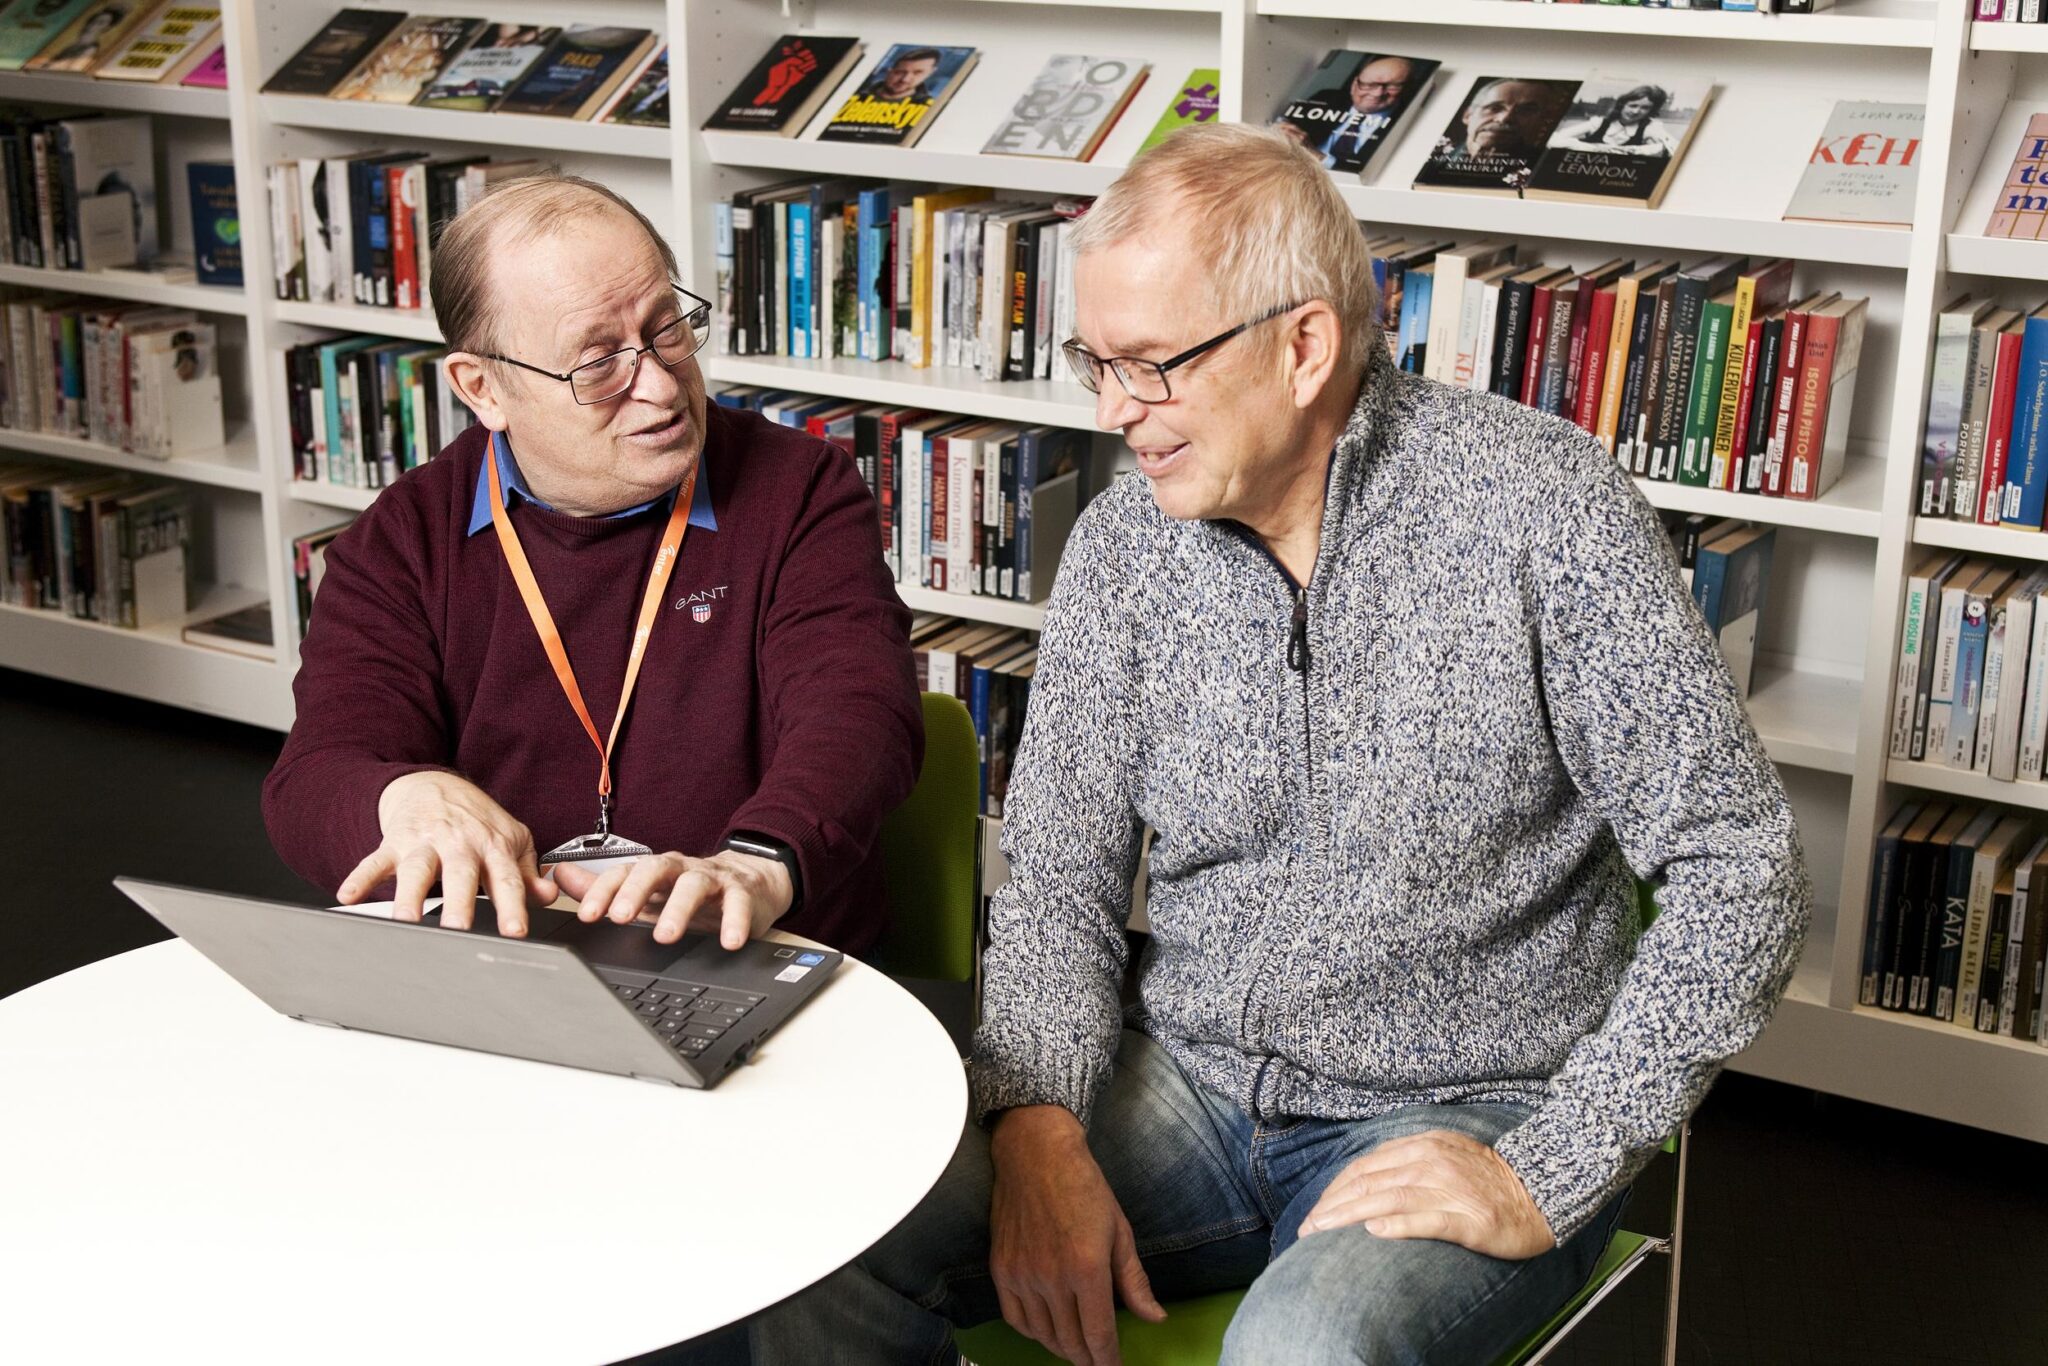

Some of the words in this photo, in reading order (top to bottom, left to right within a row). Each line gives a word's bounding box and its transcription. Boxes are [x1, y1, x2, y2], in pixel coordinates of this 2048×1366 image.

[1284, 104, 1391, 129] ILONIEMI
[1557, 161, 1638, 181] LENNON,
[1563, 151, 1609, 166] EEVA
[1014, 271, 1026, 297] GAME
[1013, 299, 1025, 325] PLAN
[1507, 290, 1521, 336] EIJA-RIITTA
[1560, 301, 1572, 338] PIRKKO
[1657, 300, 1670, 331] MARSKI
[1501, 337, 1515, 376] KORHOLA
[1667, 331, 1685, 380] ANTERO
[1722, 344, 1744, 402] KULLERVO
[1585, 351, 1600, 402] KOULUMIES
[1647, 359, 1661, 401] VARJONSA
[1978, 363, 1989, 388] JAN
[1658, 382, 1676, 442] SVENSSON
[1716, 404, 1735, 452] MANNER
[1967, 420, 1982, 484] ENSIMMÄI
[910, 450, 918, 506] KAMALA
[933, 475, 946, 512] HANNA
[952, 456, 968, 517] Kunnon
[910, 510, 918, 558] HARRIS
[953, 520, 966, 550] mies
[654, 547, 668, 576] enter
[675, 585, 728, 610] GANT
[1909, 591, 1923, 616] HANS
[631, 630, 644, 659] enter
[1904, 617, 1919, 655] ROSLING
[1942, 636, 1955, 666] Hauras
[1940, 667, 1951, 693] elämä
[1941, 896, 1966, 949] KATA
[1963, 950, 1977, 988] KULL
